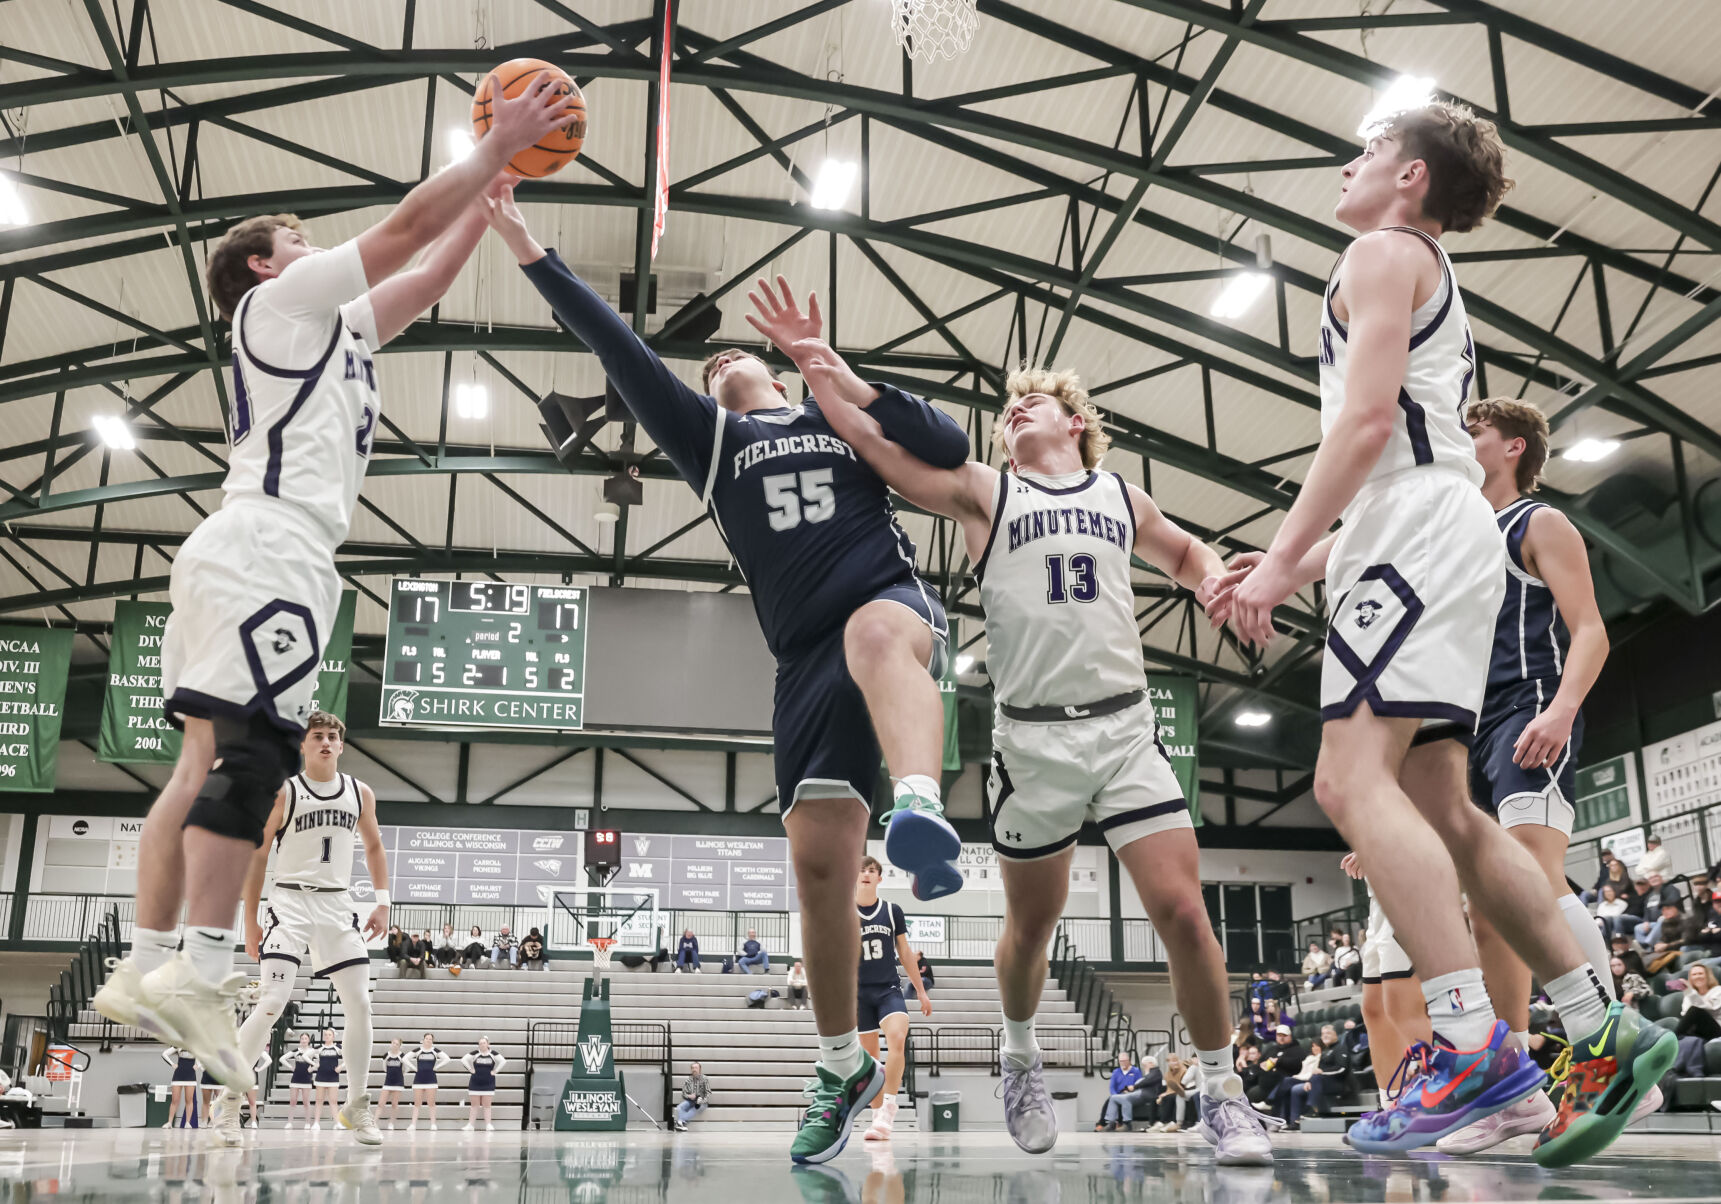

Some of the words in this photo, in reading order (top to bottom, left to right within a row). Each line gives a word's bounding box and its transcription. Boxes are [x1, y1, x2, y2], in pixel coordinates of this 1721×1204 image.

[734, 434, 857, 480] FIELDCREST
[762, 467, 836, 532] 55
[1008, 507, 1127, 554] MINUTEMEN
[1045, 552, 1100, 604] 13
[397, 580, 439, 593] LEXINGTON
[469, 583, 528, 613] 5:19
[537, 588, 581, 600] FIELDCREST
[415, 596, 440, 623] 17
[555, 603, 579, 630] 17
[475, 631, 500, 642] period
[508, 622, 522, 643] 2
[0, 640, 40, 654] NCAA
[472, 649, 501, 660] PLAYER
[0, 660, 20, 673] IV.
[23, 661, 40, 674] III
[420, 697, 485, 716] SHIRK
[494, 701, 577, 720] CENTER
[134, 737, 162, 750] 2001
[416, 831, 451, 841] COLLEGE
[452, 833, 502, 842] CONFERENCE
[320, 836, 332, 864] 1
[410, 839, 421, 848] OF
[423, 840, 454, 849] ILLINOIS
[455, 840, 463, 849] &
[465, 841, 507, 850] WISCONSIN
[695, 840, 726, 849] ILLINOIS
[726, 841, 764, 850] WESLEYAN
[716, 849, 743, 857] TITANS
[408, 857, 446, 865] AUGUSTANA
[473, 859, 502, 867] CARROLL
[976, 856, 989, 864] OF
[472, 866, 502, 874] PIONEERS
[408, 883, 442, 891] CARTHAGE
[919, 920, 942, 928] TITAN
[919, 930, 941, 938] BAND
[862, 938, 884, 961] 13
[571, 1093, 613, 1103] ILLINOIS
[566, 1102, 618, 1113] WESLEYAN
